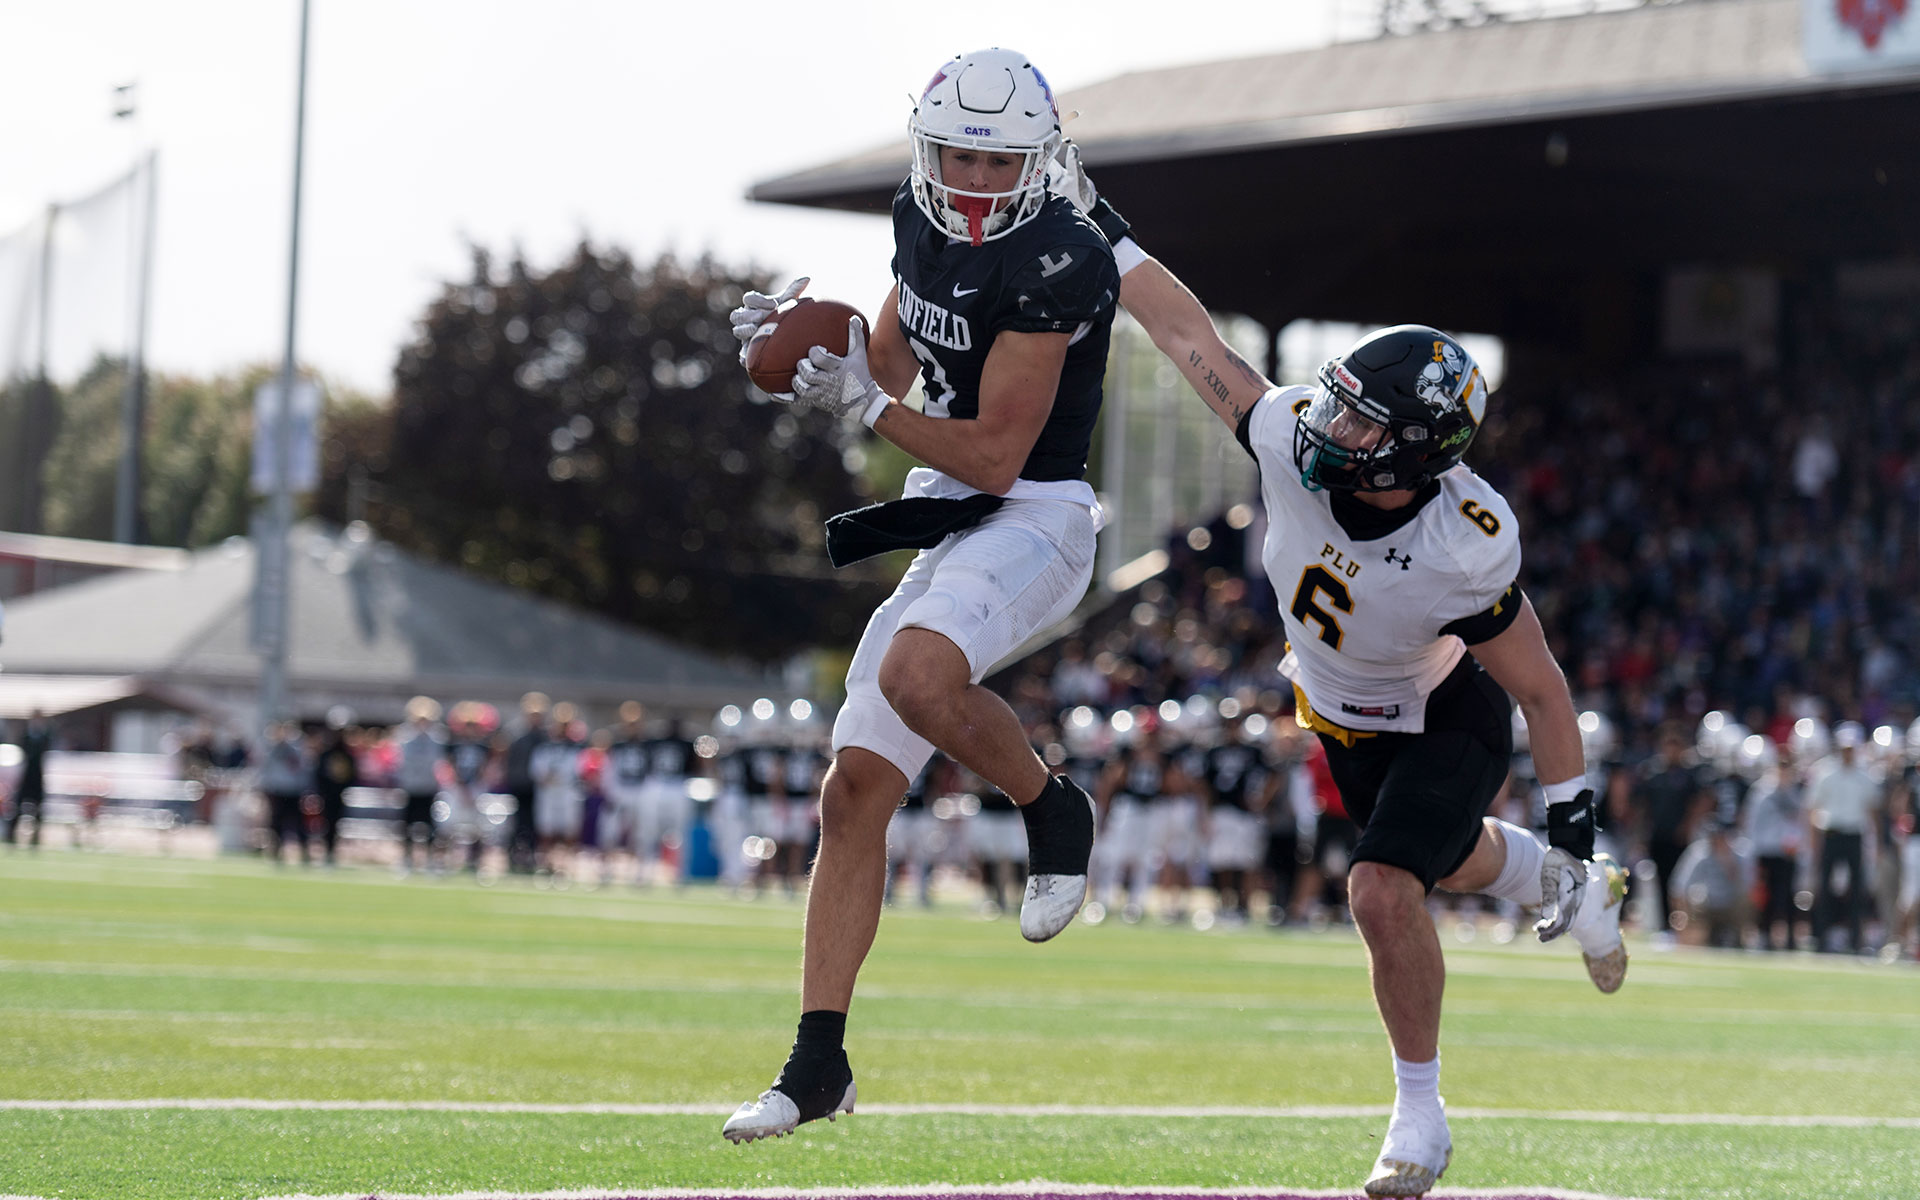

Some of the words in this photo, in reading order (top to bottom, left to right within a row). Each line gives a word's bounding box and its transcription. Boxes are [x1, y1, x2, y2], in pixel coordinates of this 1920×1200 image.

[964, 126, 992, 137] CATS
[1336, 367, 1358, 391] Riddell
[1459, 499, 1501, 538] 6
[1320, 542, 1361, 579] PLU
[1290, 563, 1356, 653] 6
